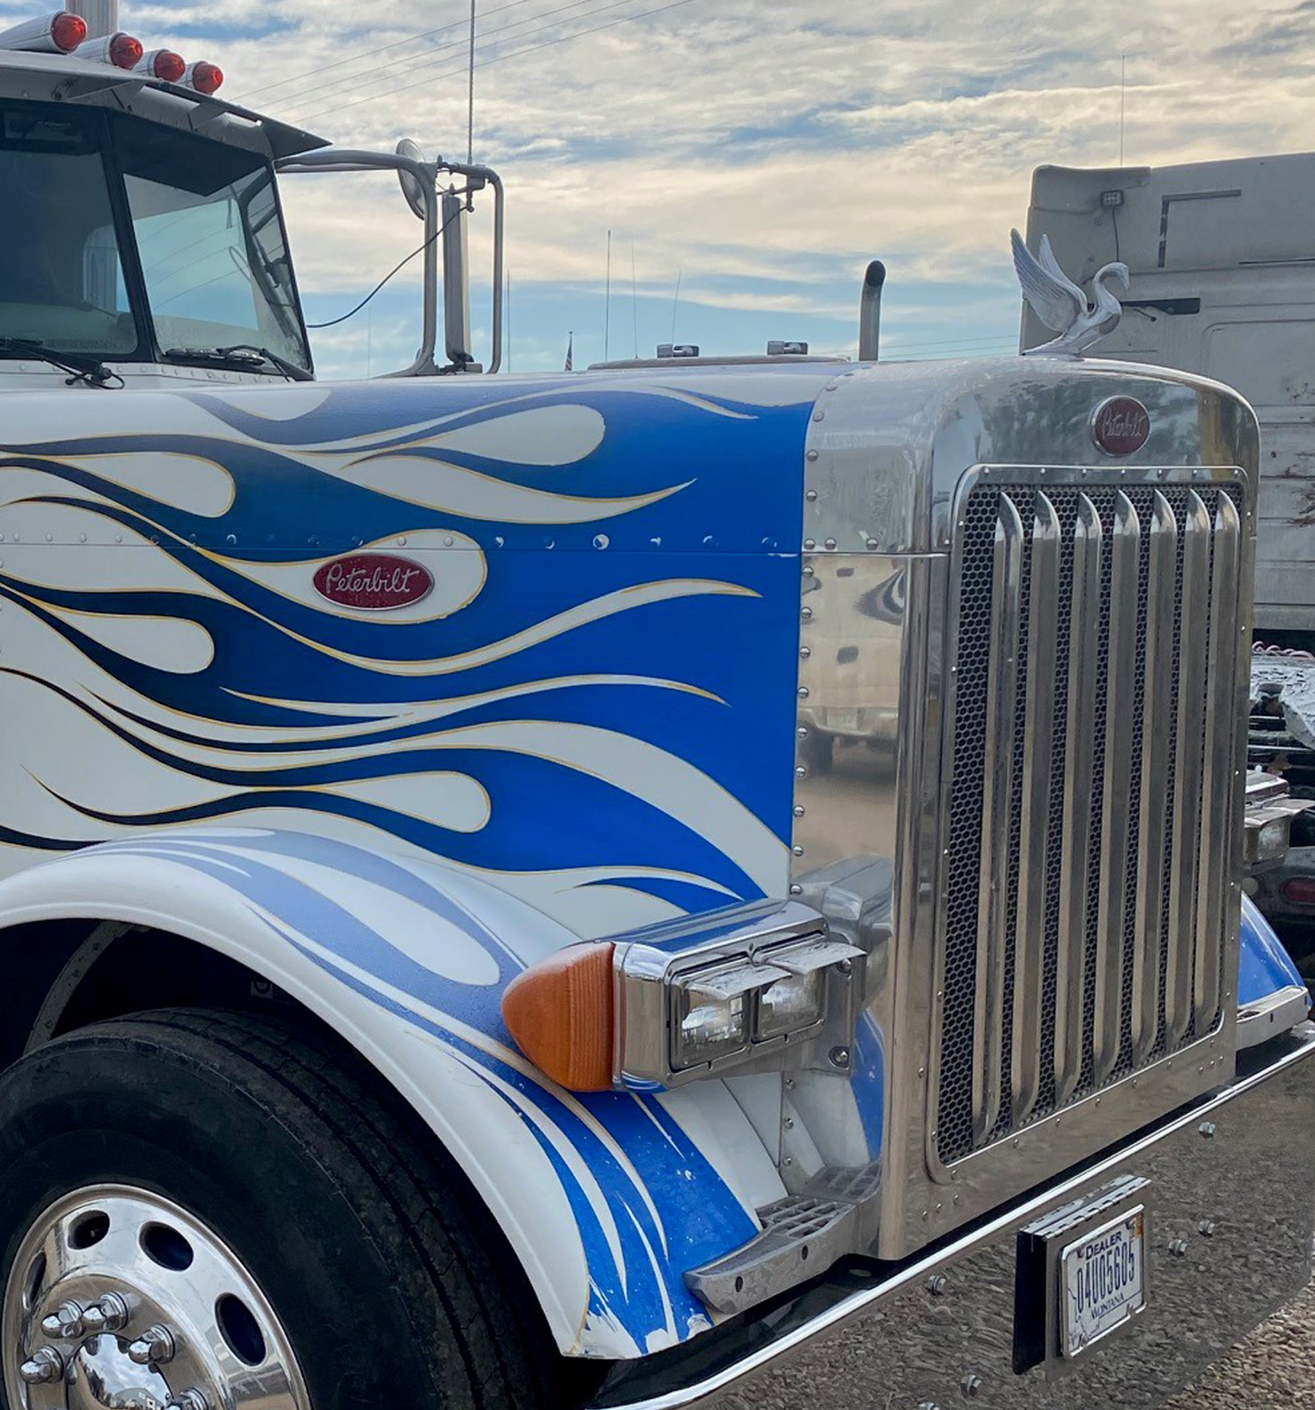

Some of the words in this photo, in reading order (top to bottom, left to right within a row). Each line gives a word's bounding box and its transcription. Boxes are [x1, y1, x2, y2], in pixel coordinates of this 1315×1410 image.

[325, 563, 420, 594] Peterbilt
[1086, 1231, 1122, 1260] DEALER
[1076, 1241, 1135, 1313] 04U05605
